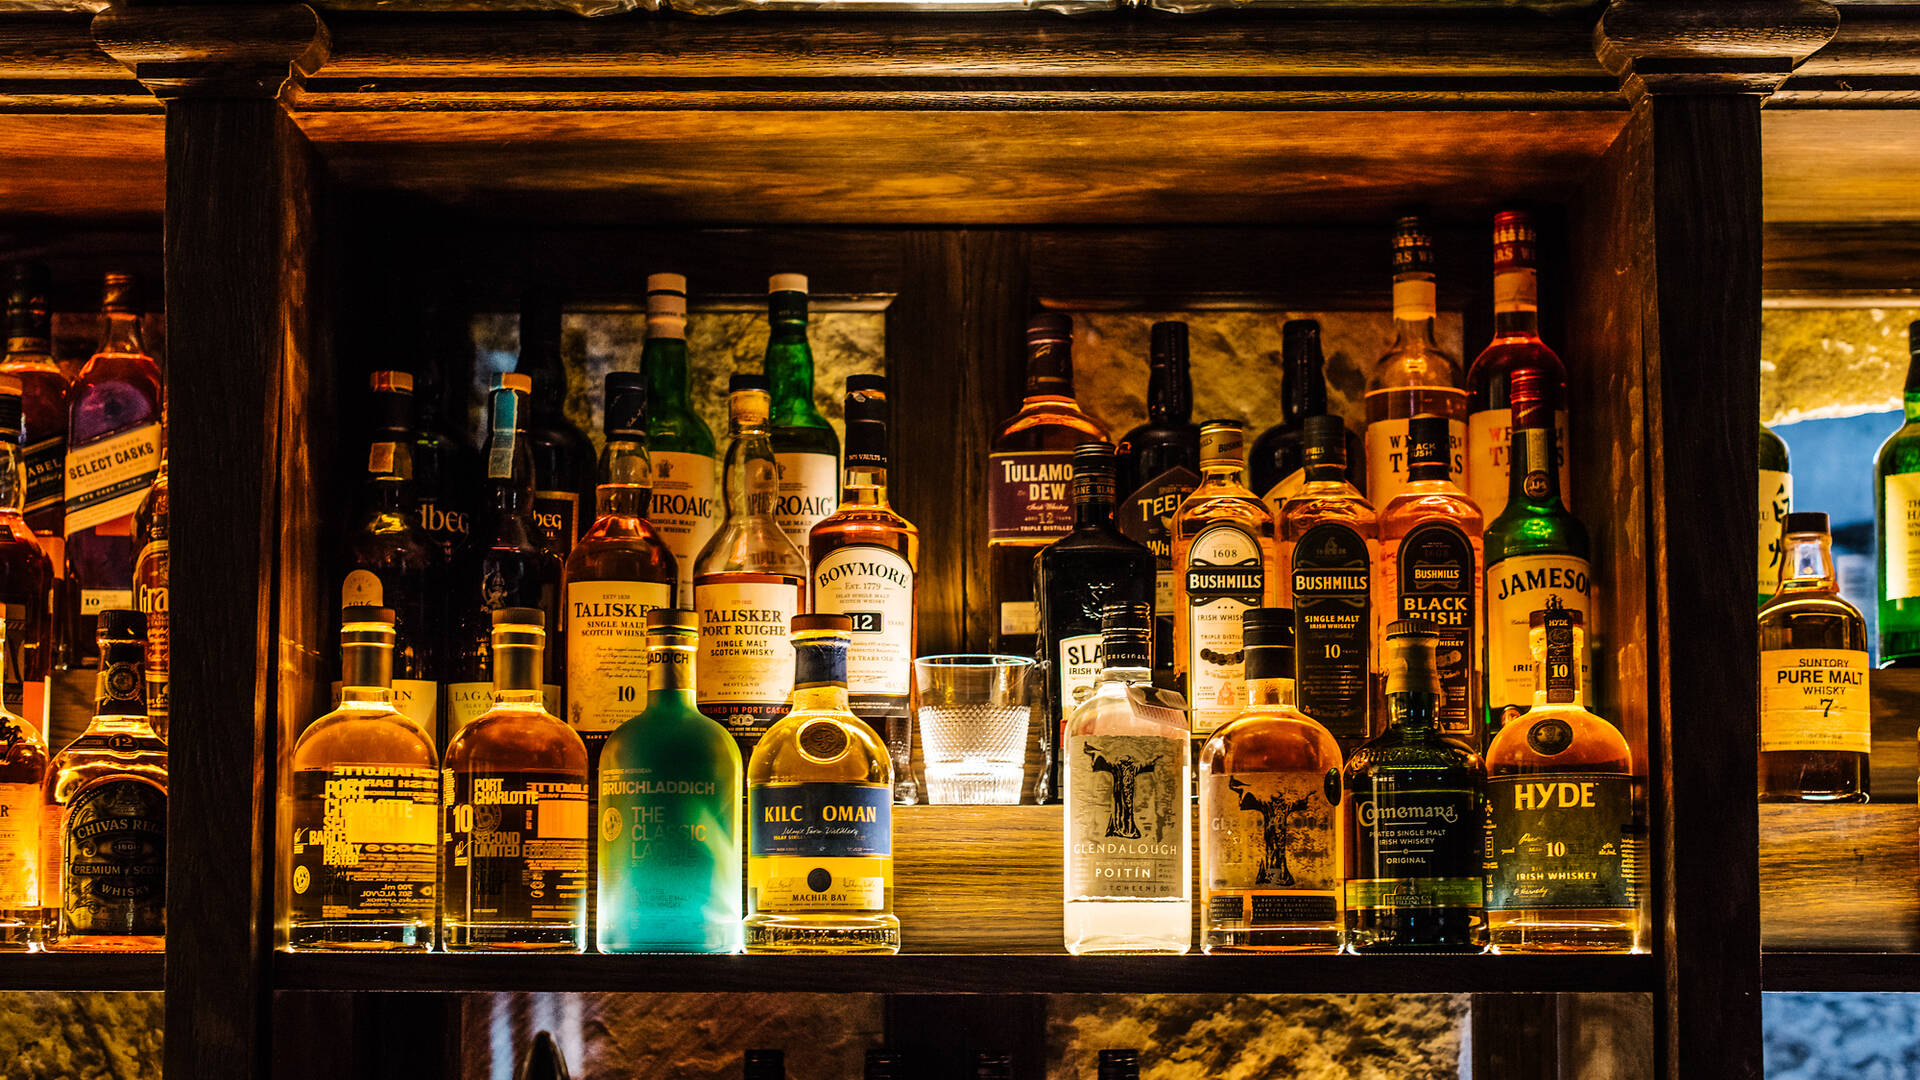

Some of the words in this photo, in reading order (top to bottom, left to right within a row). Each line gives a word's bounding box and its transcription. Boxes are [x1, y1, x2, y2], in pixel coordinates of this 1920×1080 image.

[28, 458, 62, 478] ABEL
[68, 456, 113, 480] SELECT
[115, 442, 155, 465] CASKS
[1001, 460, 1073, 483] TULLAMO
[1029, 483, 1066, 501] DEW
[1038, 512, 1054, 524] 12
[1213, 550, 1237, 558] 1608
[819, 562, 907, 589] BOWMORE
[1190, 573, 1262, 589] BUSHMILLS
[1415, 569, 1459, 579] BUSHMILLS
[1296, 575, 1367, 590] BUSHMILLS
[1498, 568, 1591, 600] JAMESON
[85, 598, 99, 606] 10
[139, 584, 169, 613] Gra
[1404, 597, 1467, 611] BLACK
[575, 603, 660, 618] TALISKE
[704, 609, 783, 623] TALISKER
[852, 614, 873, 630] 12
[1304, 615, 1335, 623] SINGLE
[1337, 615, 1360, 623] MALT
[702, 625, 732, 636] PORT
[735, 625, 786, 637] RUIGHE
[716, 640, 743, 648] SINGLE
[746, 640, 767, 648] MALT
[648, 652, 689, 664] ADDICH
[711, 648, 740, 656] SCOTCH
[742, 648, 775, 656] WHISKY
[1068, 645, 1101, 666] SLA
[1324, 644, 1341, 659] 10
[1513, 664, 1533, 672] IRI
[1799, 658, 1849, 668] SUNTORY
[1069, 667, 1092, 675] IRISH
[1551, 664, 1568, 678] 10
[1777, 670, 1823, 683] PURE
[1829, 671, 1863, 685] MALT
[616, 685, 635, 702] 10
[1803, 686, 1846, 695] WHISKY
[741, 706, 763, 714] PORT
[1820, 699, 1833, 717] 7
[114, 735, 133, 747] 12
[474, 779, 504, 792] PORT
[602, 781, 715, 796] BRUICHLADDICH
[474, 791, 539, 805] CHARLOTTE
[1514, 782, 1596, 810] HYDE
[453, 805, 473, 833] 10
[632, 806, 664, 823] THE
[765, 805, 877, 823] KILCOMAN
[77, 819, 128, 839] CHIVAS
[475, 832, 520, 845] SECOND
[1379, 838, 1398, 846] IRISH
[474, 844, 520, 857] LIMITED
[1073, 843, 1177, 855] GLENDALOUGH
[1545, 841, 1566, 857] 10
[74, 865, 121, 874] PREMIUM
[1095, 866, 1151, 878] POITÍN
[1516, 872, 1544, 881] IRISH
[1548, 871, 1597, 880] WHISKEY
